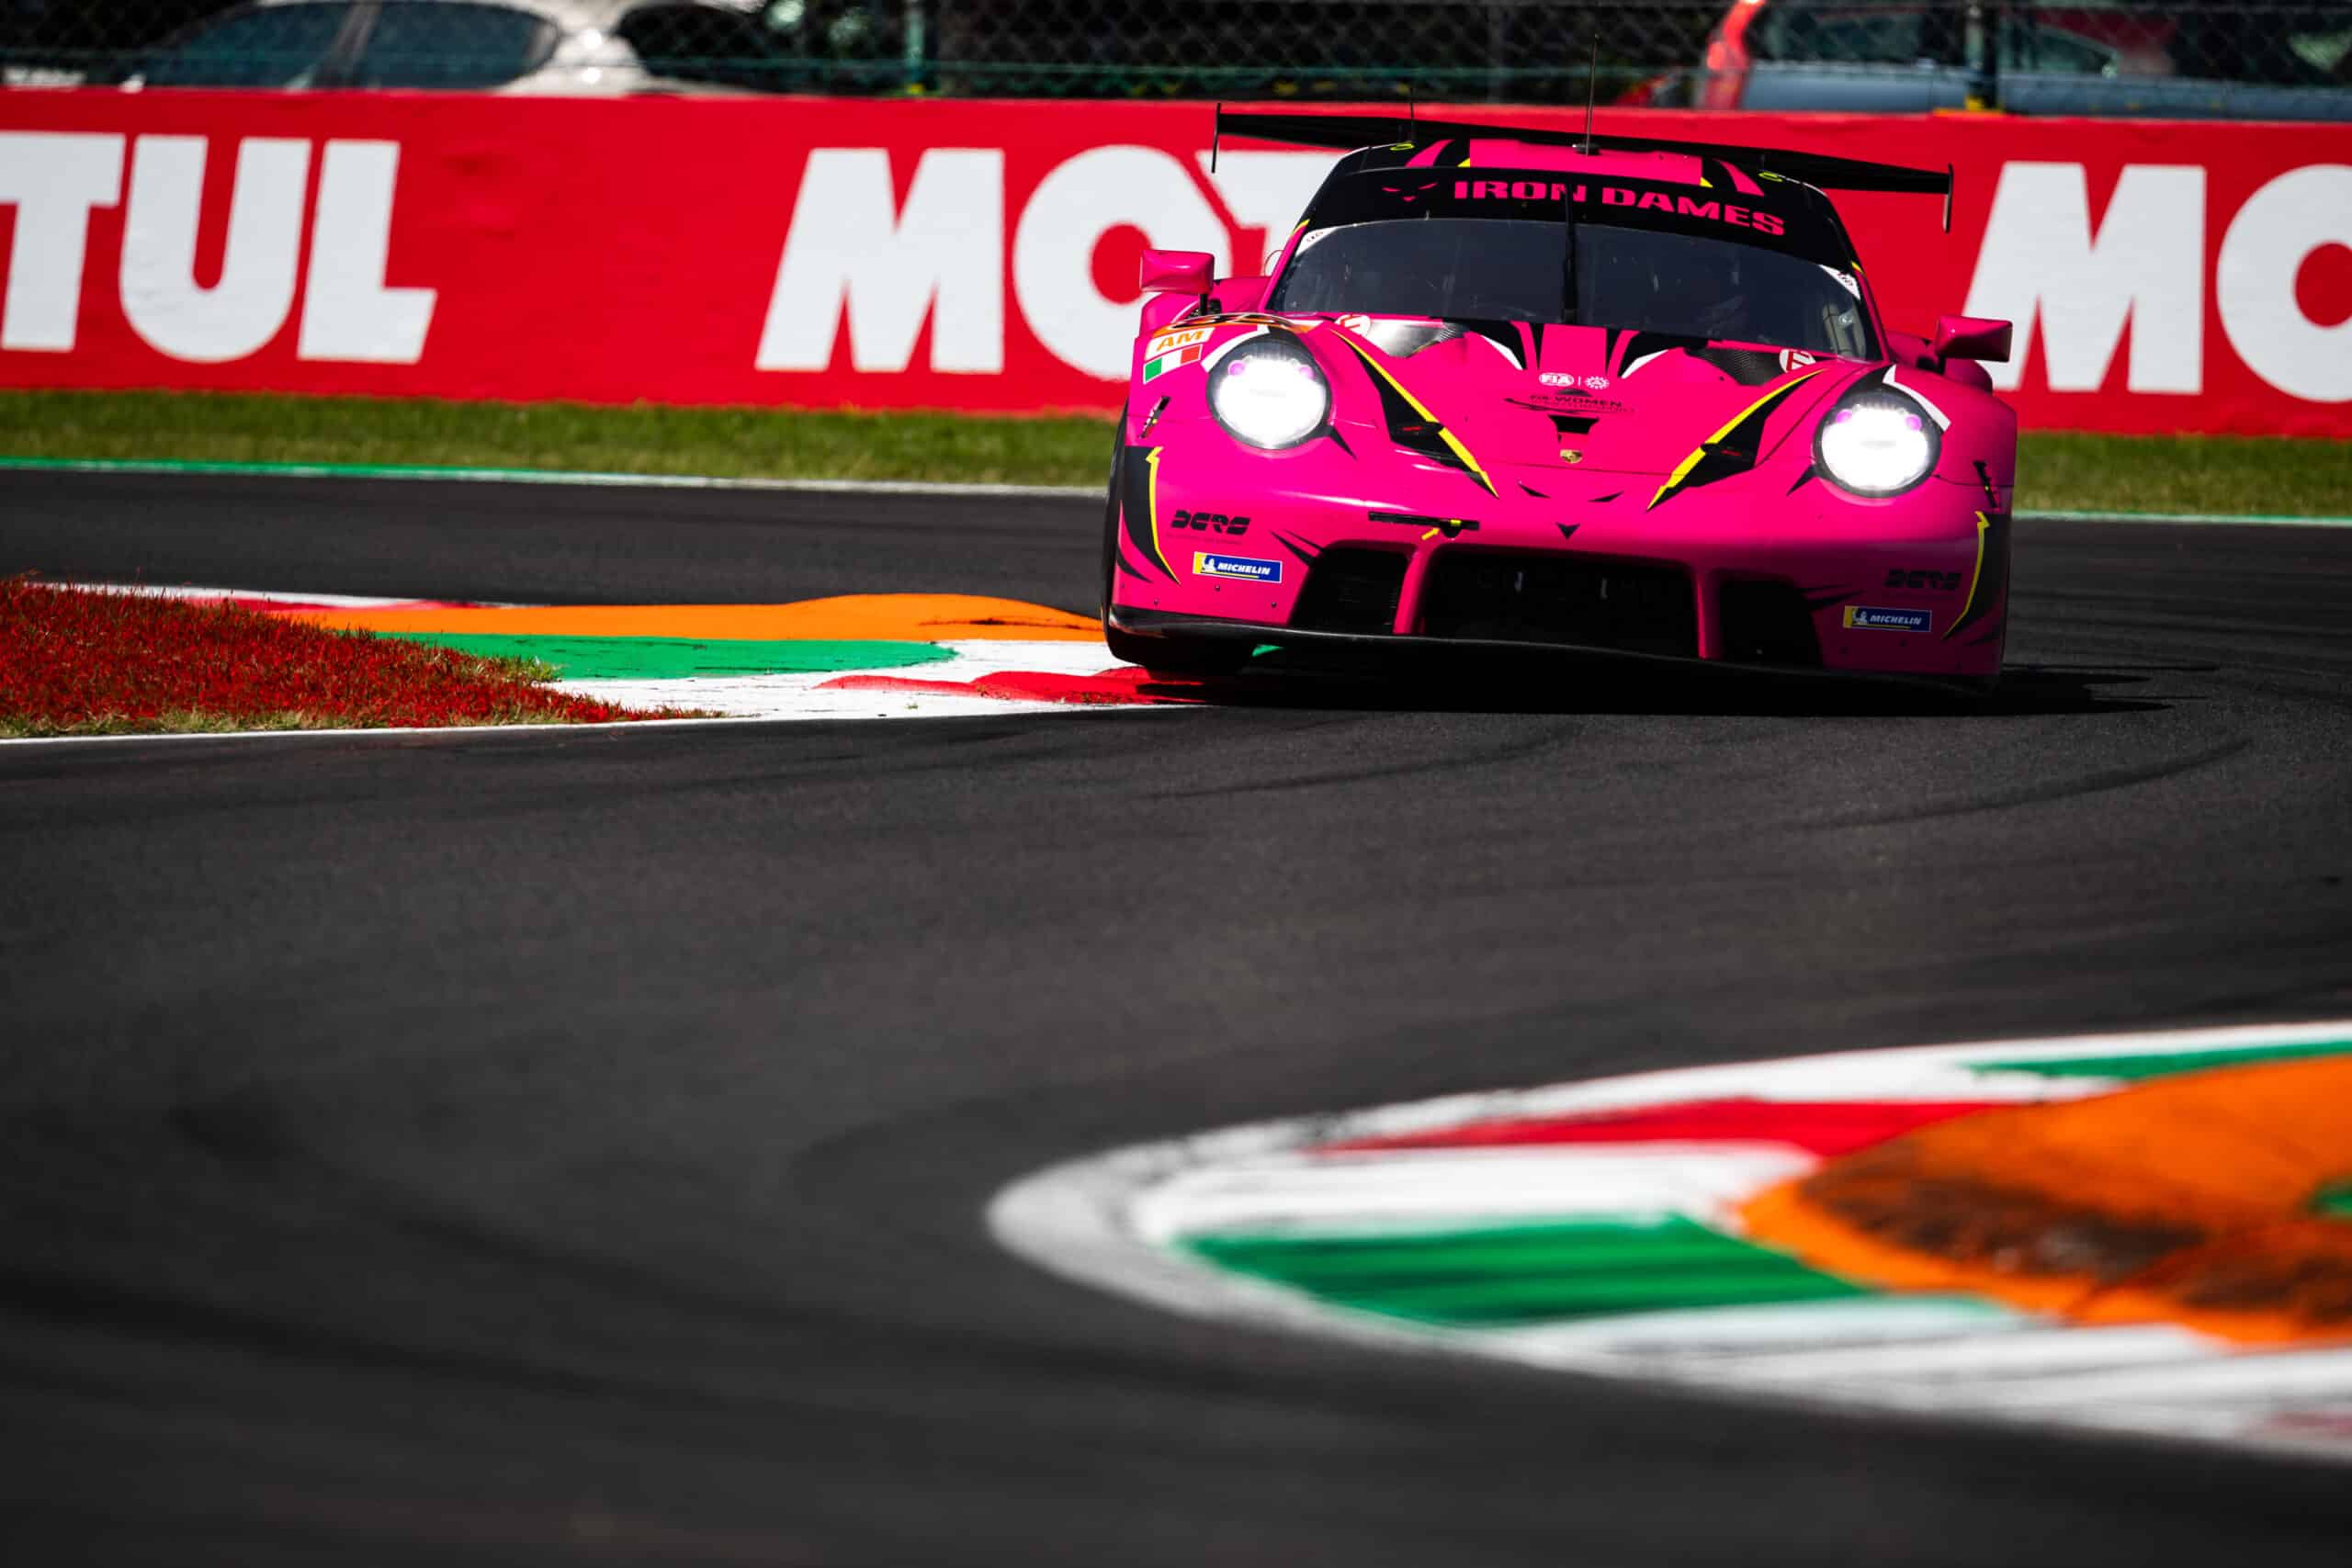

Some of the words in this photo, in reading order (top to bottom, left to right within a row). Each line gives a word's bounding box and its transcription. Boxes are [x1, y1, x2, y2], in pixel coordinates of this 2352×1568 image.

[1454, 180, 1587, 202] IRON
[1601, 186, 1785, 236] DAMES
[1156, 329, 1206, 352] AM
[1217, 561, 1272, 576] MICHELIN
[1870, 614, 1922, 626] MICHELIN
